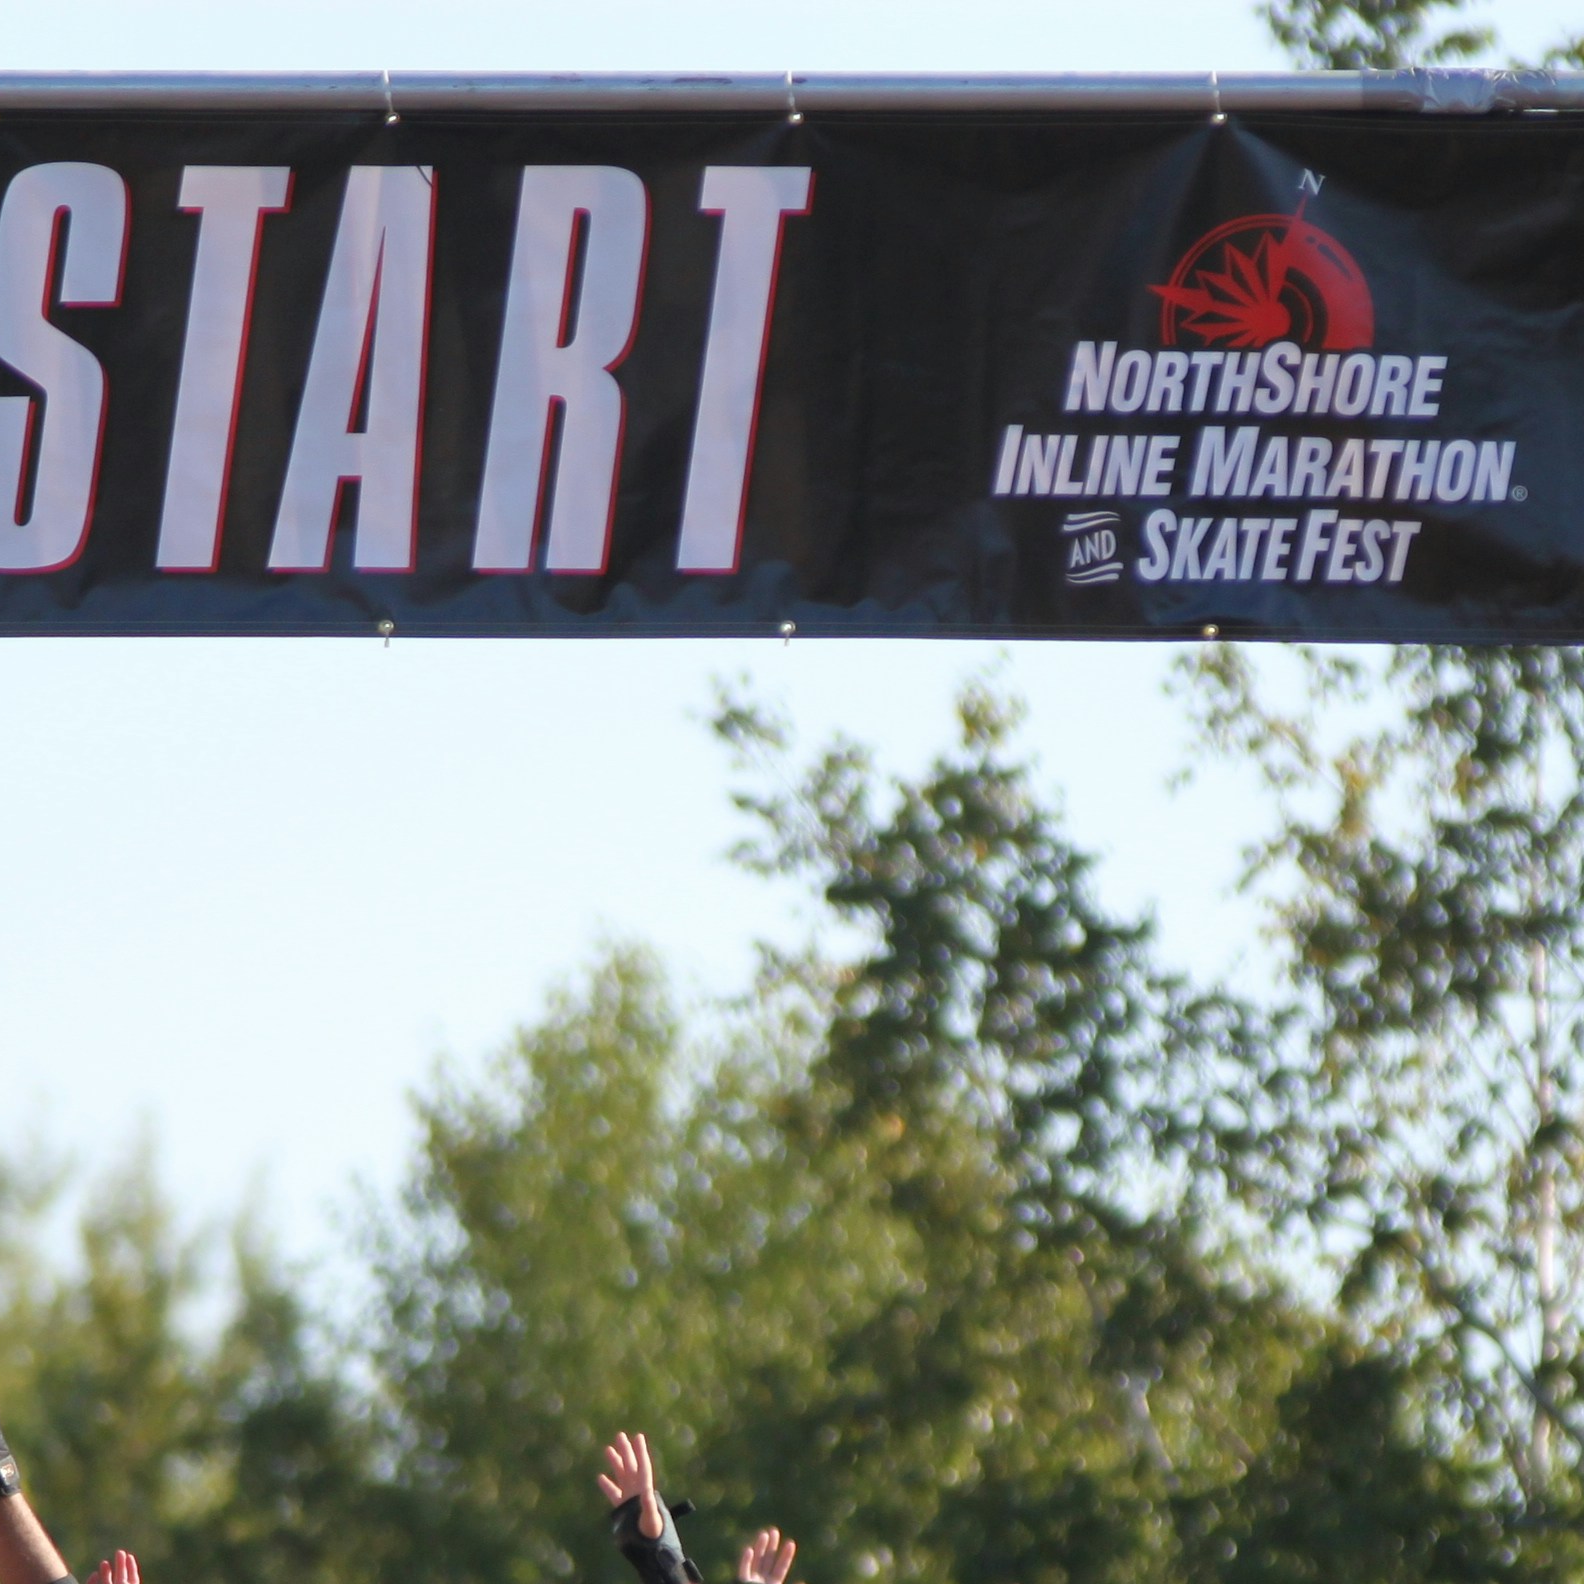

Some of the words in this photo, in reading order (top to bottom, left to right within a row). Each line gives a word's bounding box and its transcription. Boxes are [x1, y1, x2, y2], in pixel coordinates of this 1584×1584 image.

[1298, 168, 1326, 196] N
[1063, 340, 1448, 417] NORTHSHORE
[992, 424, 1179, 496] INLINE
[1070, 528, 1116, 567] AND
